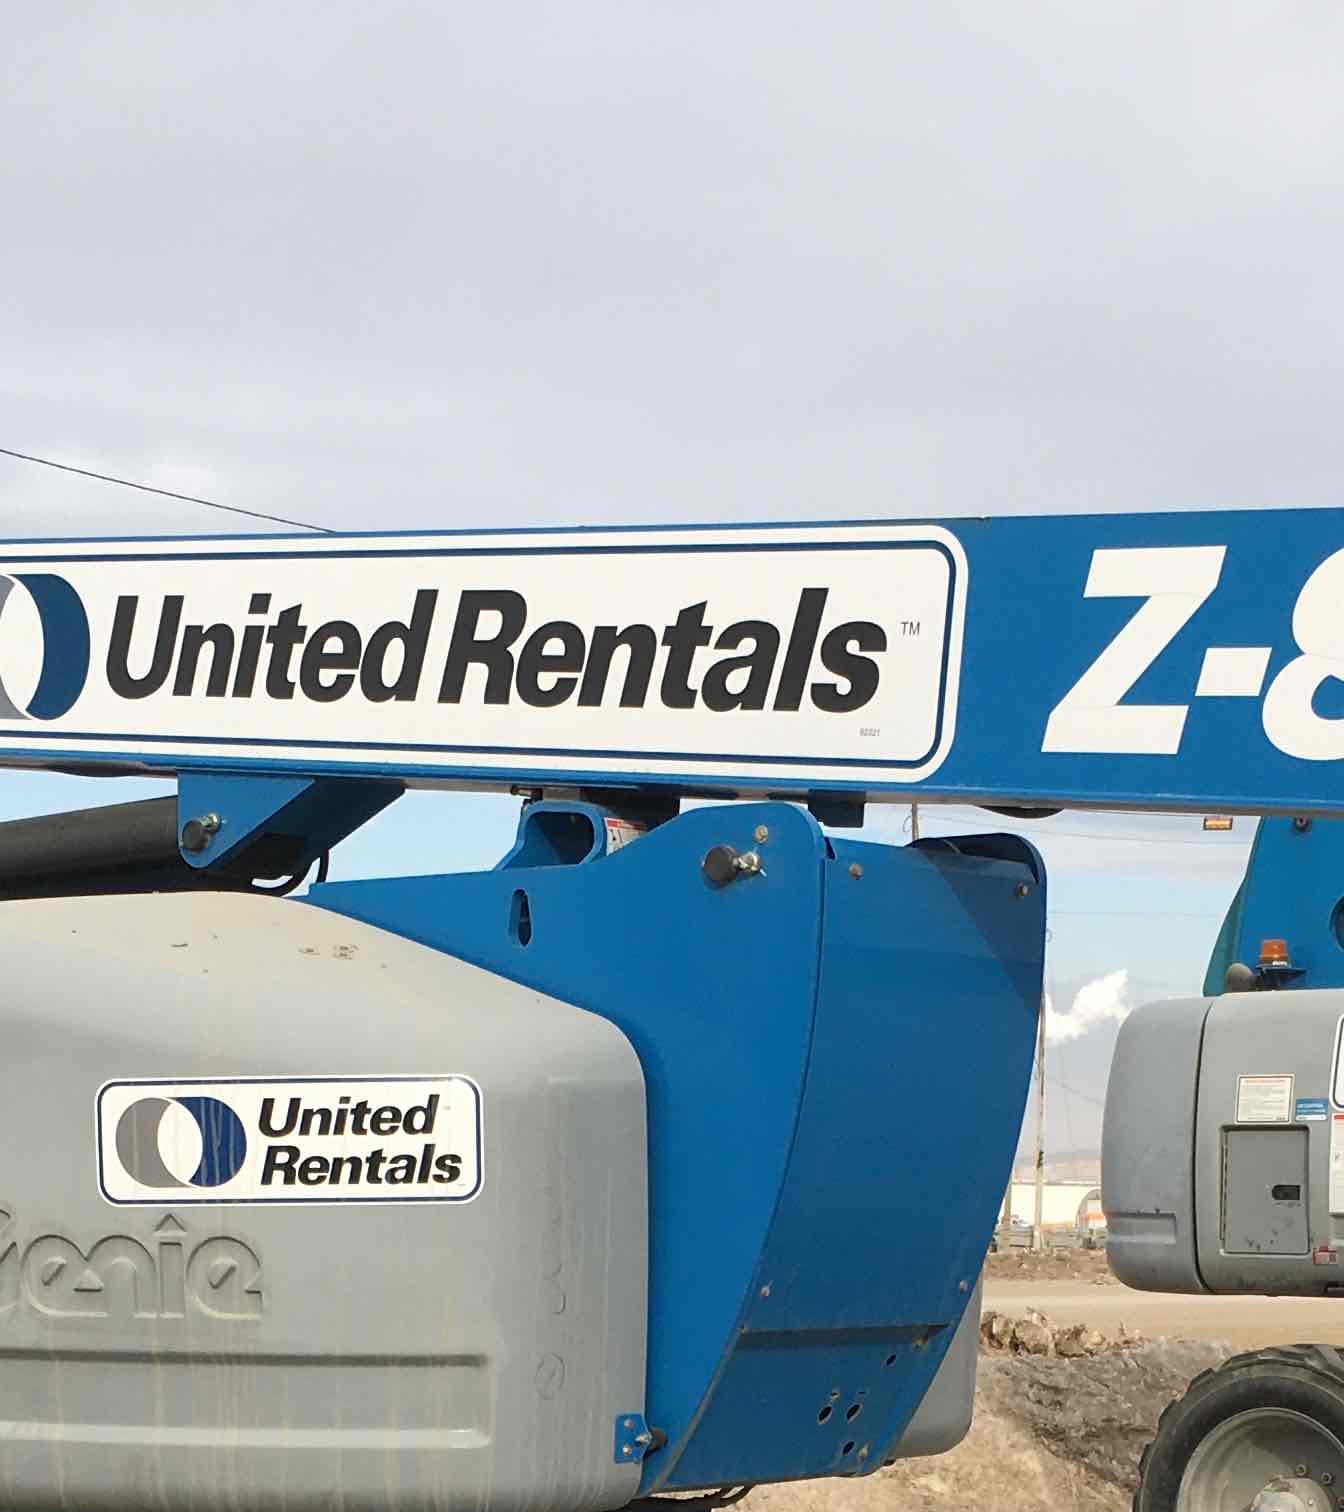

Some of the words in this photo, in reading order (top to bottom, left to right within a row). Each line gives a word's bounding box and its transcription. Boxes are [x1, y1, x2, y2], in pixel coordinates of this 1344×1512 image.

[104, 588, 436, 704] United
[437, 588, 888, 714] Rentals
[258, 1094, 441, 1137] United
[260, 1143, 463, 1186] Rentals
